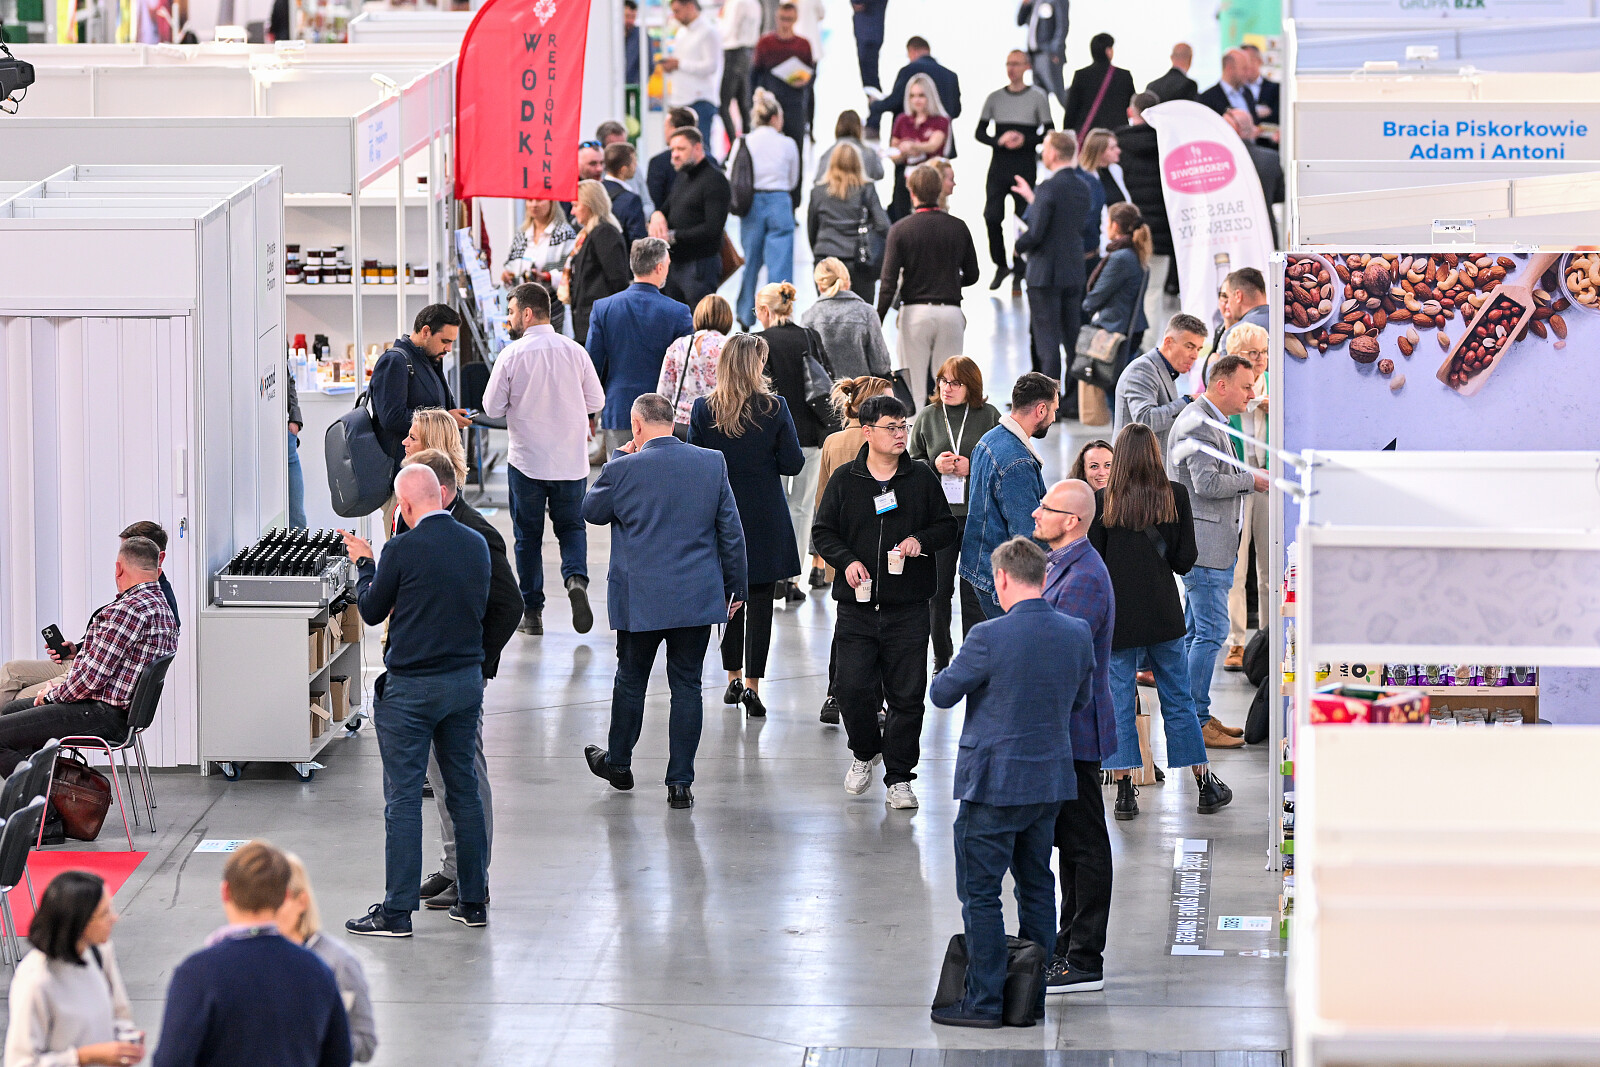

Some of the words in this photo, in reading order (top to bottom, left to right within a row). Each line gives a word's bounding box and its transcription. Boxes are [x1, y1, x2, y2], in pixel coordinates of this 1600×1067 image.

[542, 33, 557, 189] REGIONALNE
[1383, 120, 1449, 137] Bracia
[1456, 120, 1588, 137] Piskorkowie
[1409, 143, 1474, 160] Adam
[1480, 142, 1486, 160] i
[1491, 142, 1565, 160] Antoni
[1173, 871, 1207, 897] produkty
[1172, 897, 1205, 916] sypkie
